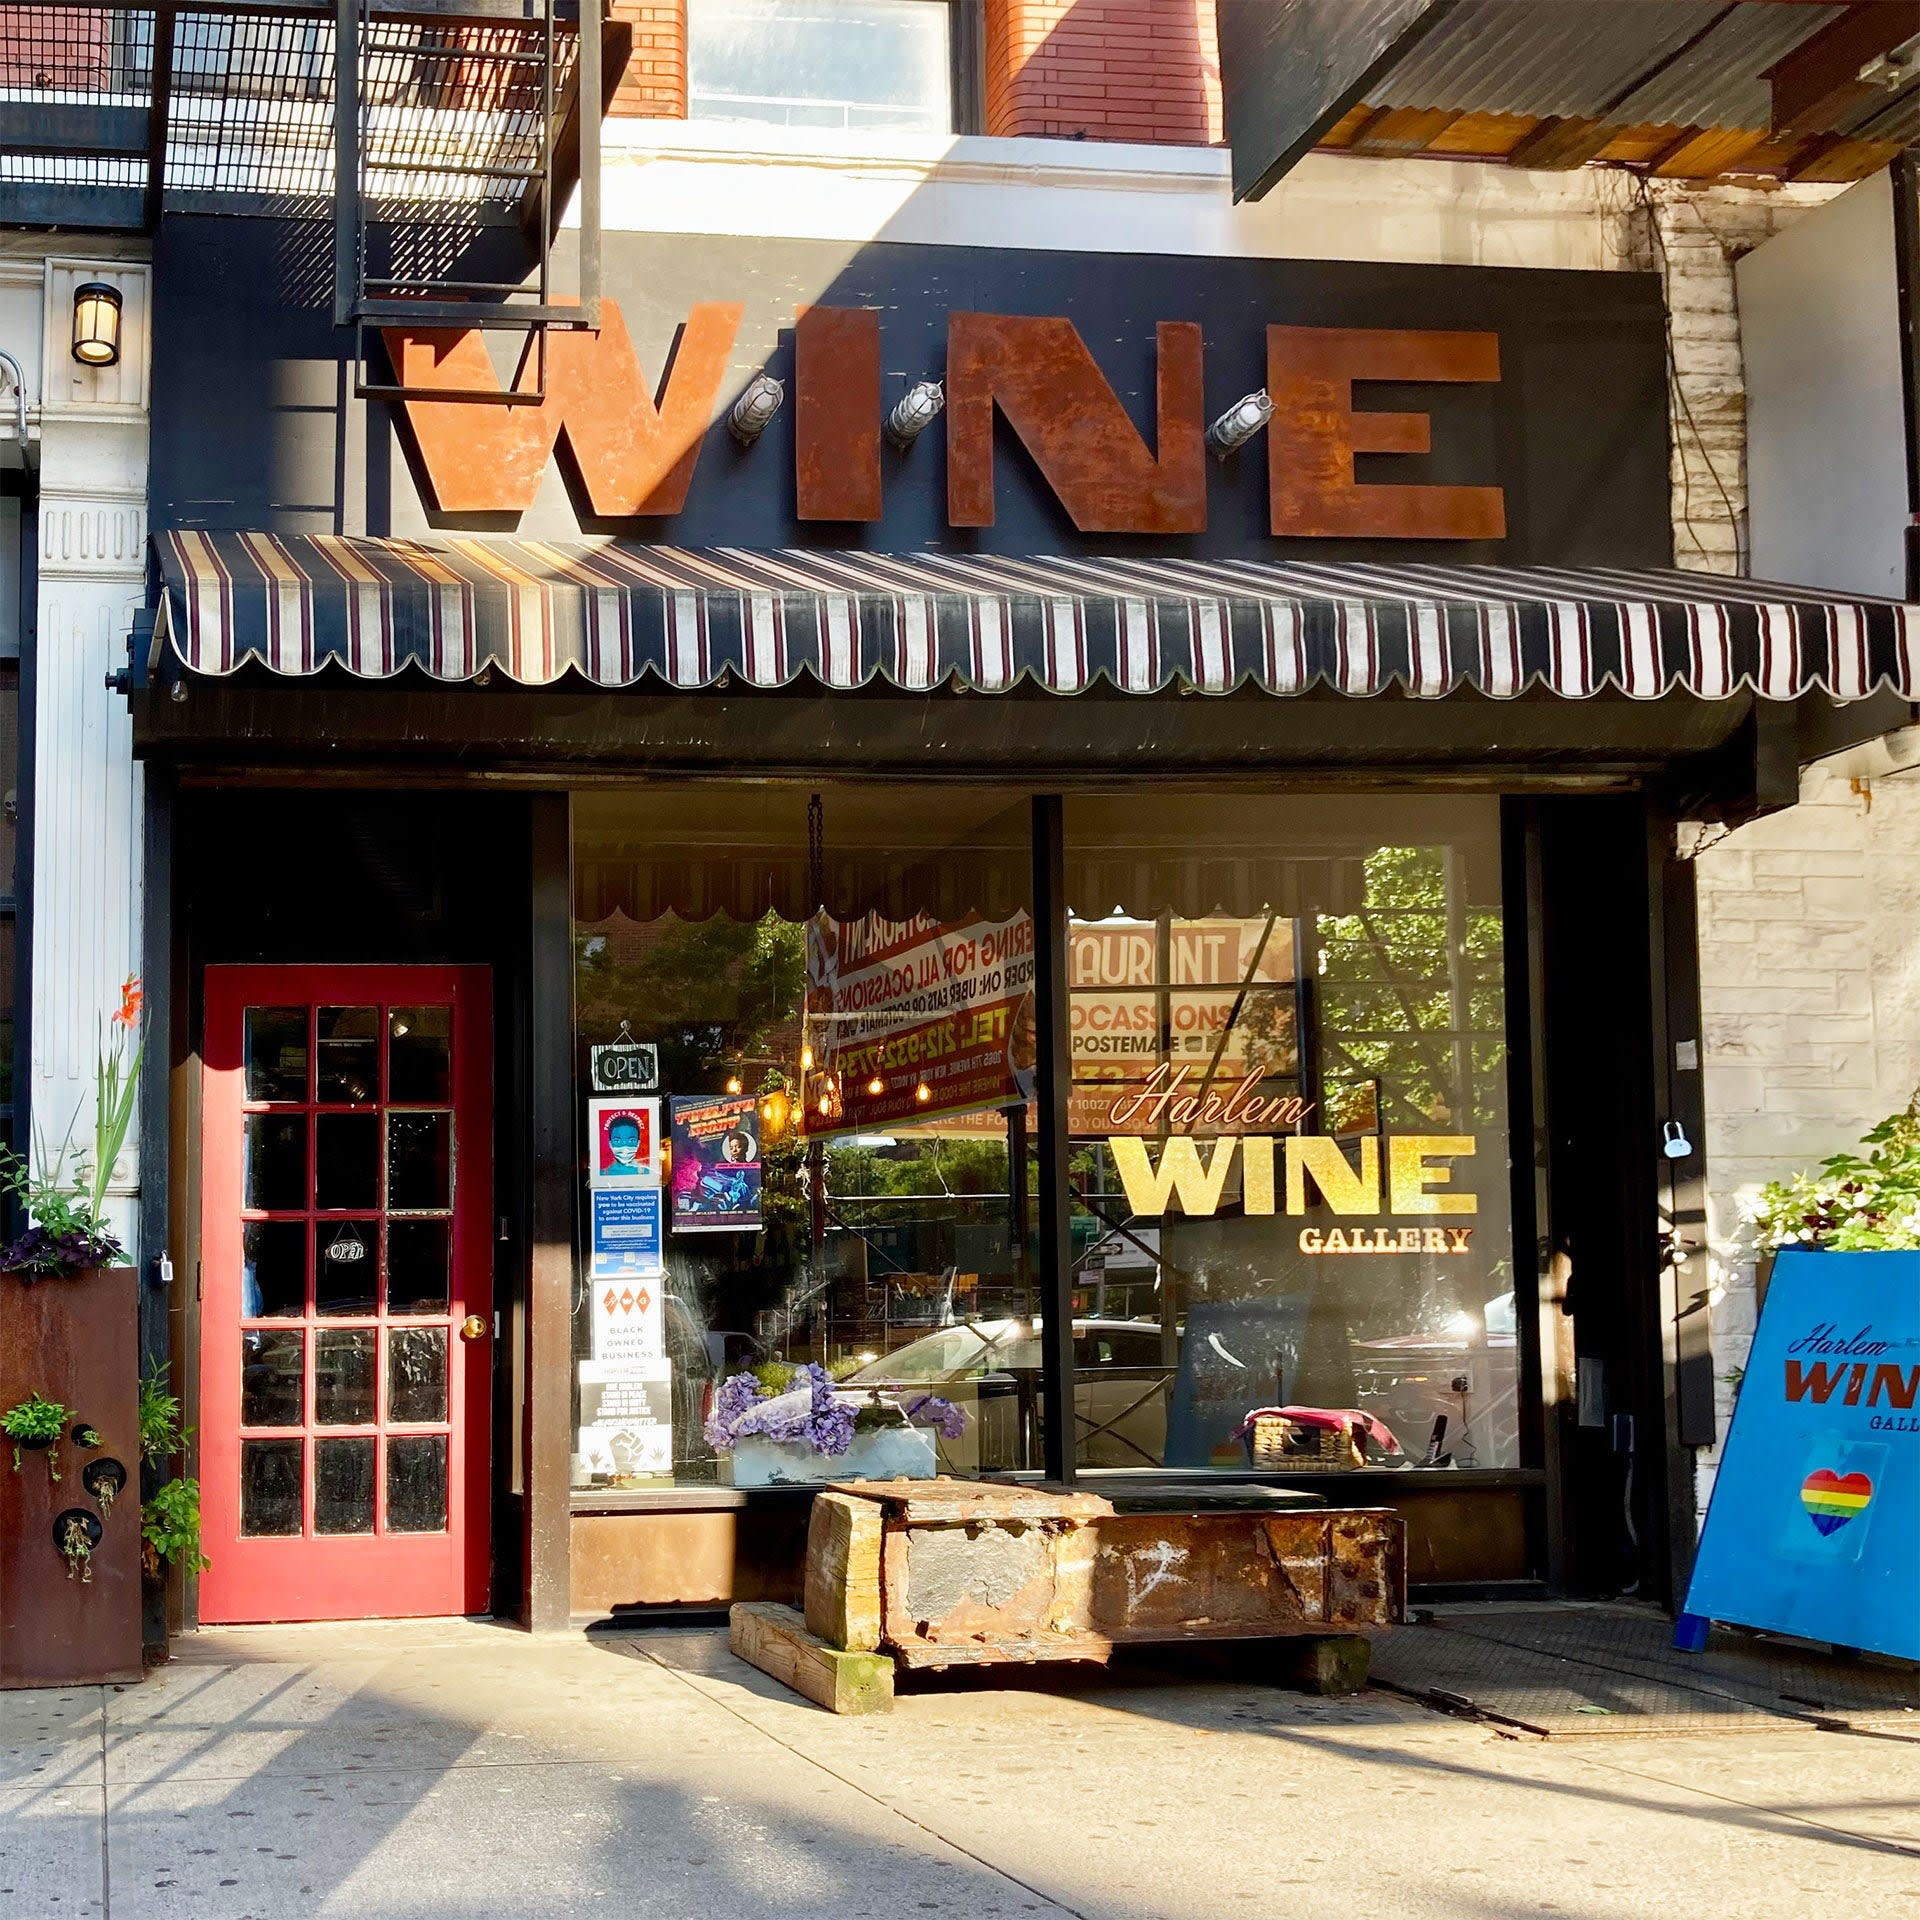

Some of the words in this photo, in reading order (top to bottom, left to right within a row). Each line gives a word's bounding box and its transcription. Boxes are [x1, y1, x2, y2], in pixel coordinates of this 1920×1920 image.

[381, 297, 1506, 540] WINE
[604, 1056, 650, 1079] OPEN
[1110, 1062, 1316, 1125] Harlem
[1108, 1136, 1478, 1216] WINE
[623, 1194, 634, 1202] City
[1299, 1228, 1473, 1256] GALLERY
[609, 1326, 644, 1334] BLACK
[1787, 1323, 1893, 1356] Harlem
[602, 1351, 654, 1360] BUSINESS
